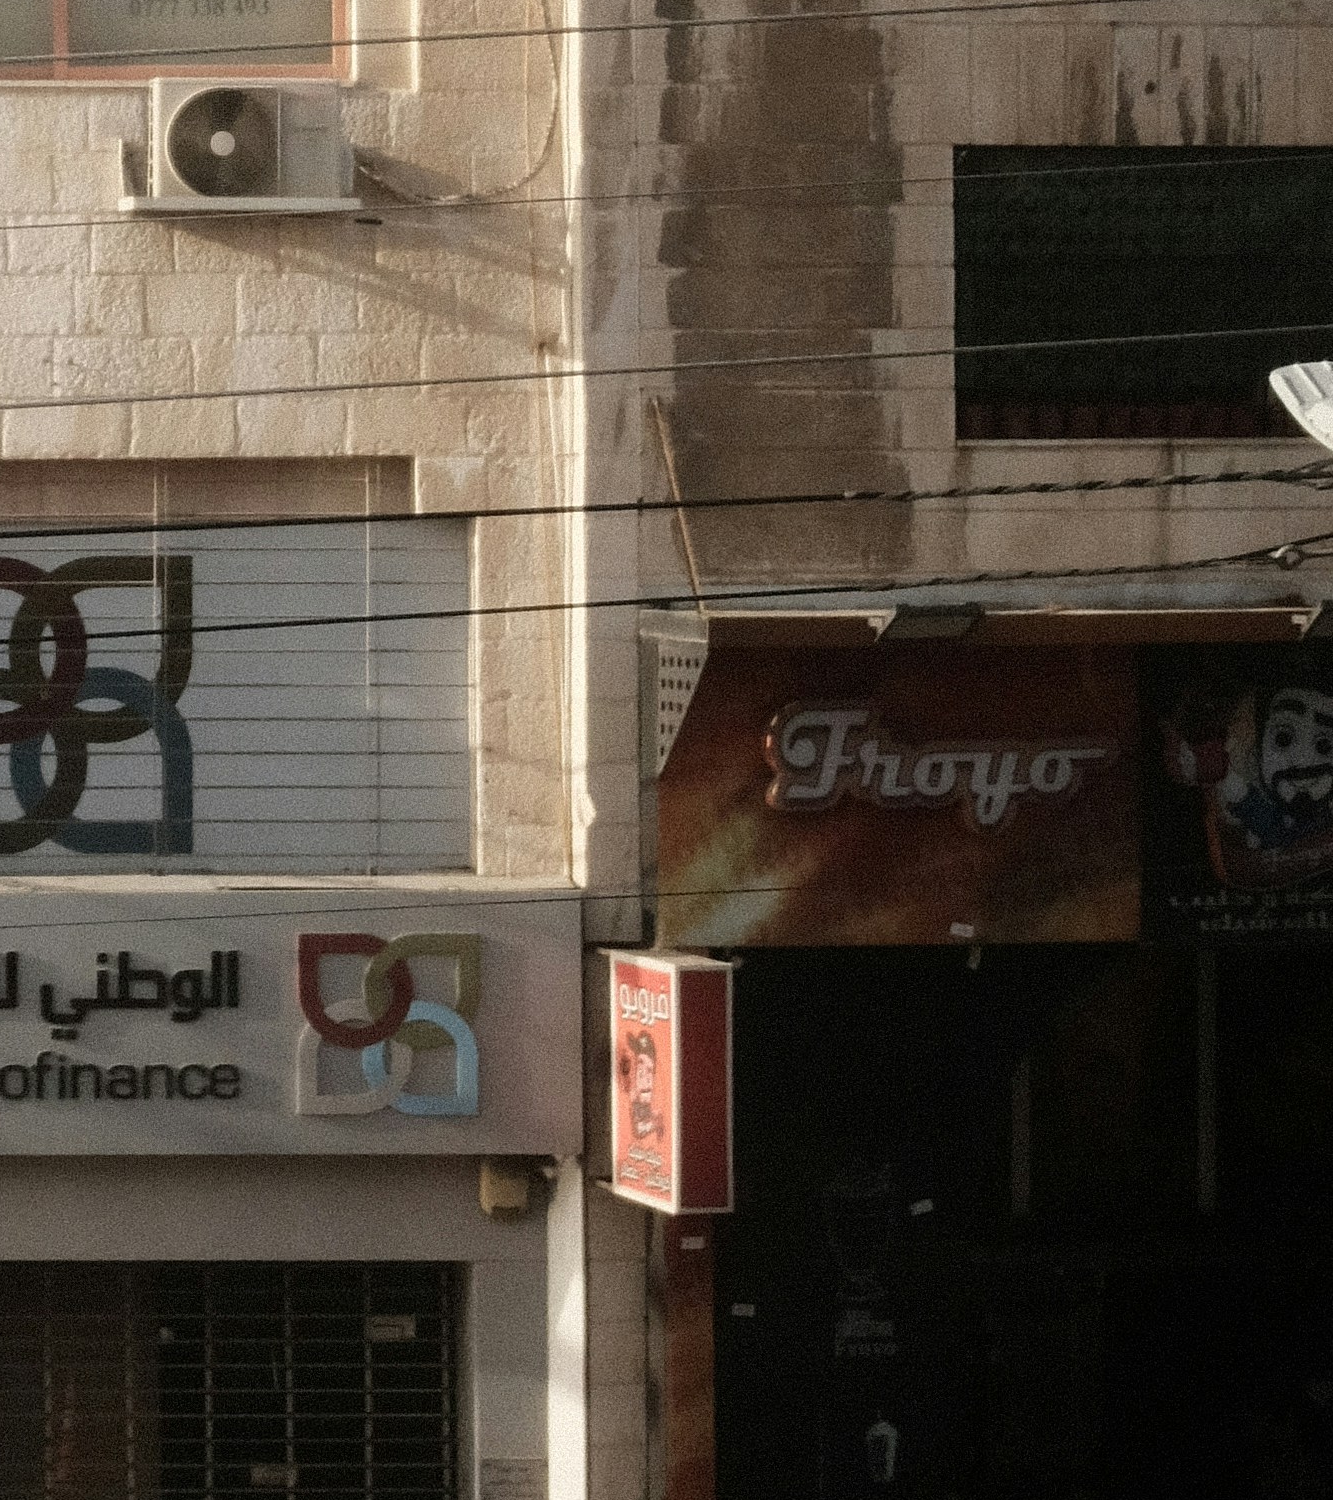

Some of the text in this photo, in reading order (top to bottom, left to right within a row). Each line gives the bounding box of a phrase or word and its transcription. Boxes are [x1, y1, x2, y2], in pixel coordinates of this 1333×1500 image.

[778, 707, 1115, 826] Froyo
[41, 950, 240, 1040] الوطني
[618, 982, 671, 1027] فرويو
